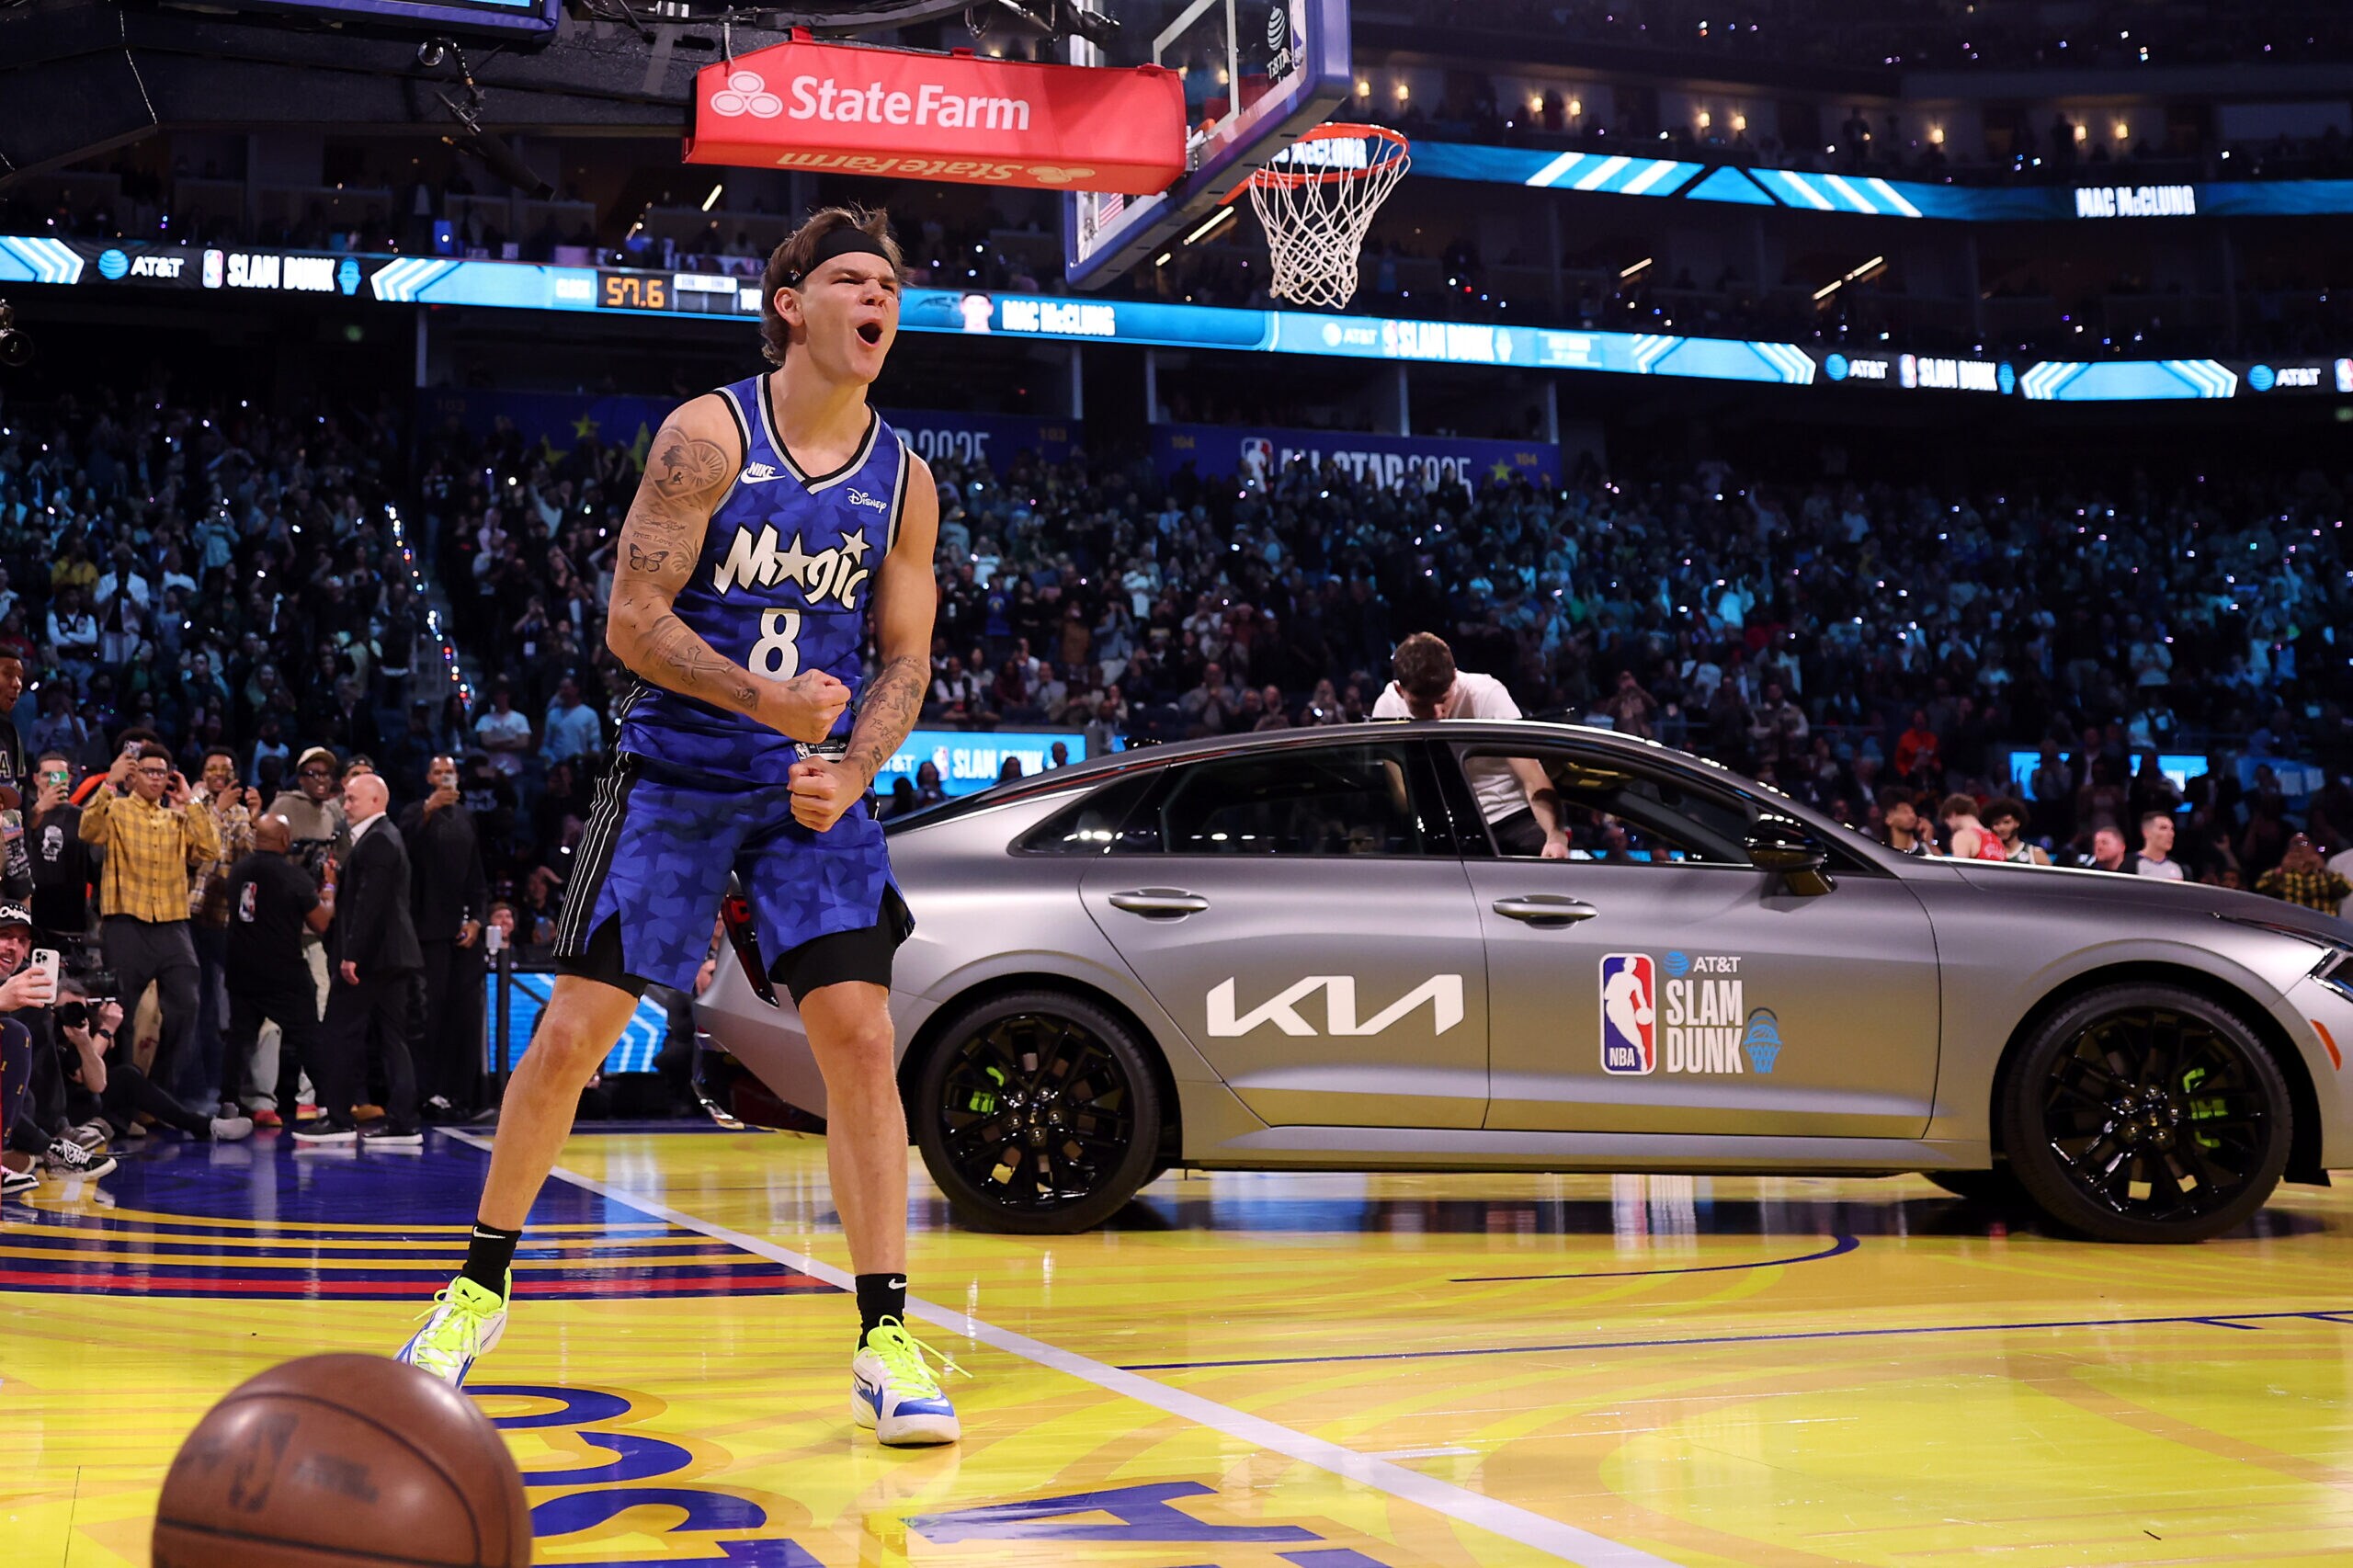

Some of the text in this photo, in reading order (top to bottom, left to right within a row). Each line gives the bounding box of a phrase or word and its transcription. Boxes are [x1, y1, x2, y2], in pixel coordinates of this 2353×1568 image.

[2075, 187, 2115, 218] MAC
[131, 256, 184, 279] AT&T
[227, 254, 335, 290] SLAM DUNK
[606, 277, 665, 309] 57.6
[1343, 327, 1377, 345] AT&T
[1398, 321, 1446, 358] SLAM
[1849, 360, 1888, 379] AT&T
[1917, 358, 1958, 388] SLAM
[2275, 368, 2321, 387] AT&T
[748, 461, 776, 477] NIKE
[748, 608, 801, 682] 8
[881, 755, 916, 772] T&T
[952, 748, 998, 779] SLAM
[1693, 956, 1742, 973] AT&T
[1206, 973, 1464, 1038] KIA
[1665, 979, 1743, 1027] SLAM
[1608, 1047, 1636, 1067] NBA
[1666, 1027, 1744, 1074] DUNK
